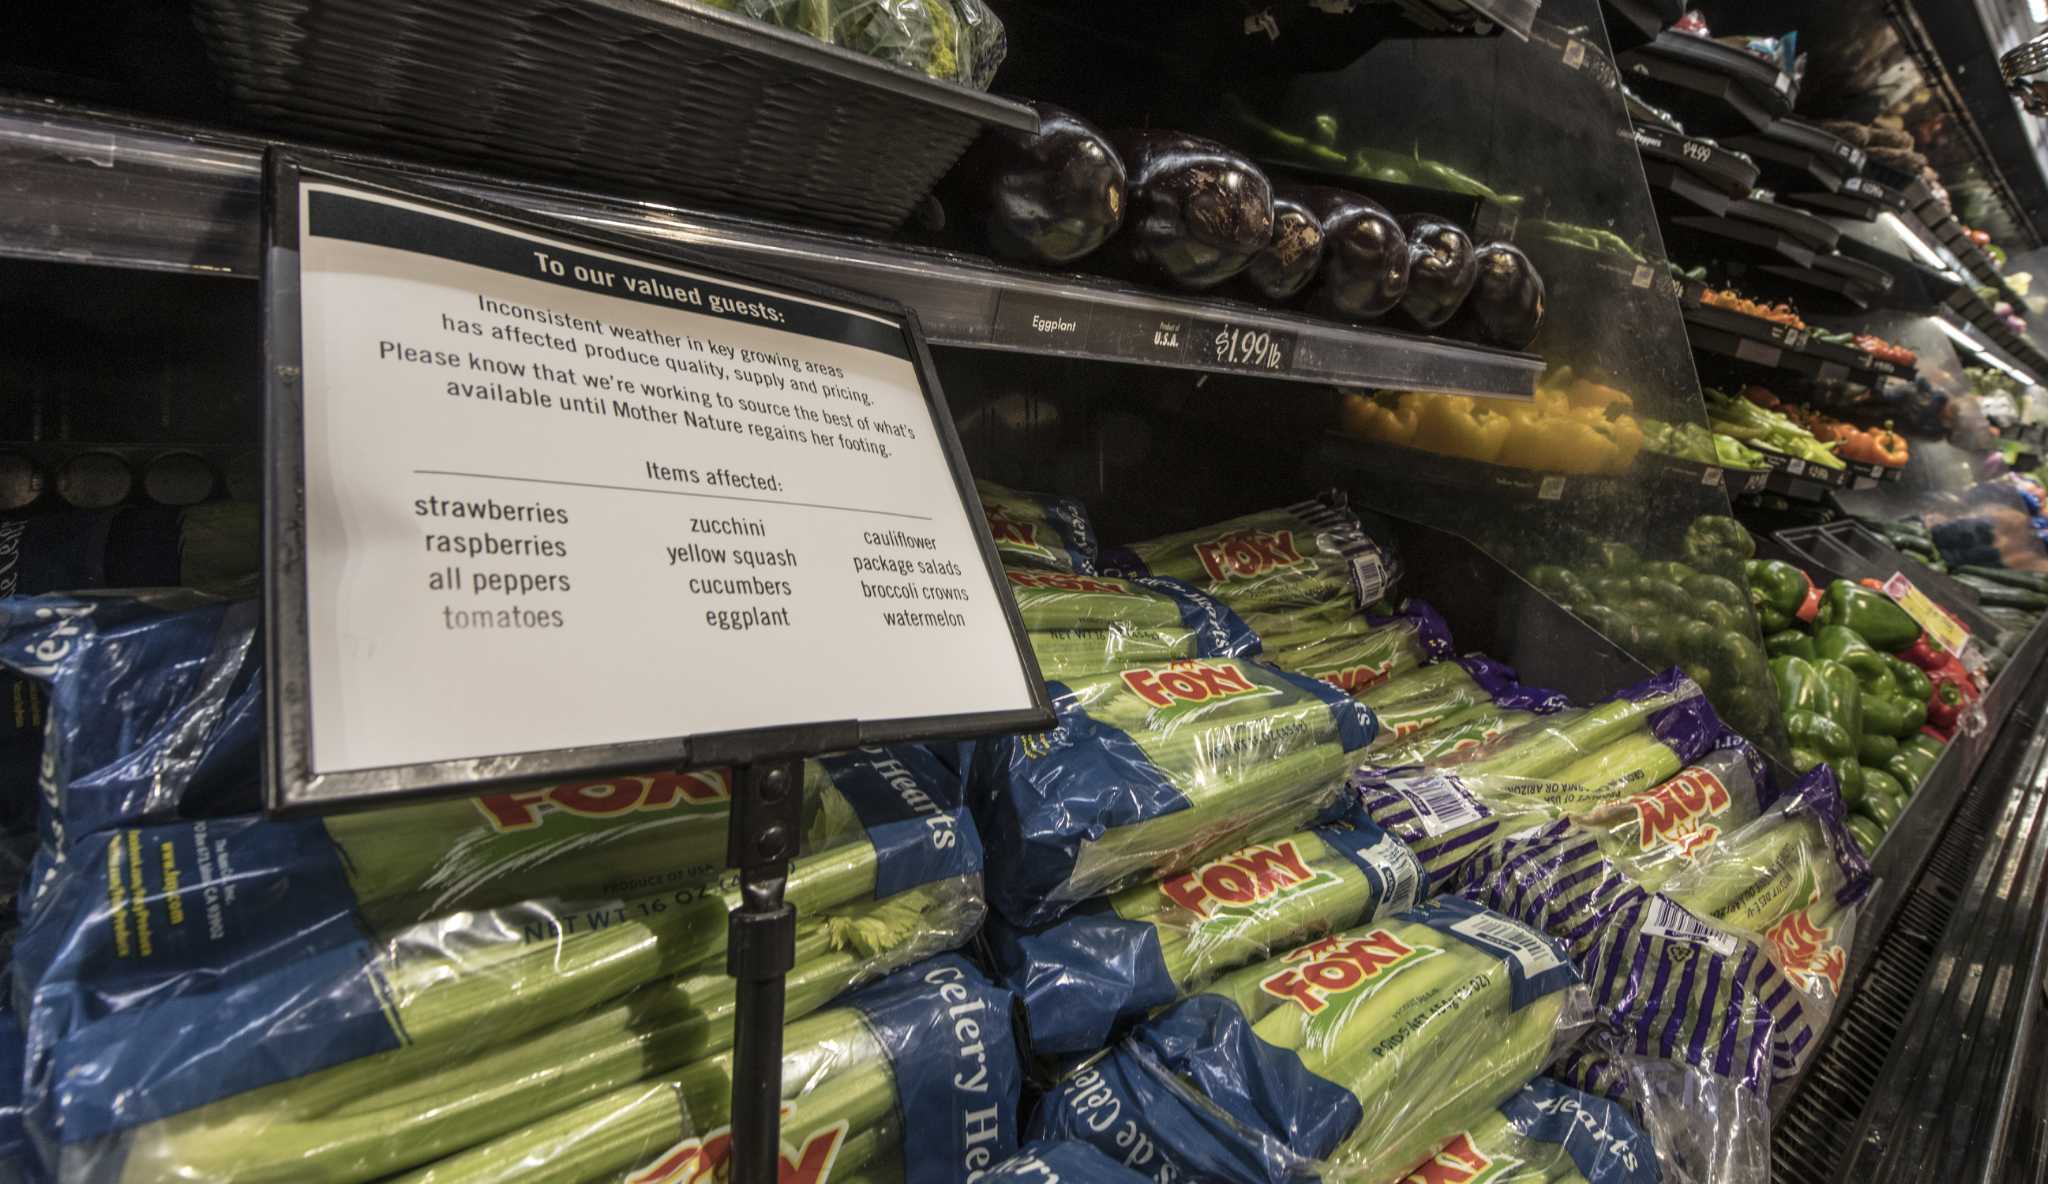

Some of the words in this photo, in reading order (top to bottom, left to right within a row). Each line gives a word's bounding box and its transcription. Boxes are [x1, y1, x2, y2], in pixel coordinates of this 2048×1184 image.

[533, 252, 565, 276] To
[574, 265, 615, 288] our
[623, 275, 702, 305] valued
[708, 294, 785, 323] guests:
[478, 295, 604, 335] Inconsistent
[610, 324, 681, 348] weather
[687, 336, 703, 352] in
[708, 340, 735, 360] key
[741, 349, 801, 373] growing
[805, 360, 844, 378] areas
[1032, 315, 1076, 333] Eggplant
[1154, 331, 1179, 347] U.S.A.
[442, 314, 483, 337] has
[492, 324, 577, 353] affected
[585, 342, 660, 367] produce
[666, 356, 730, 380] quality,
[734, 368, 785, 391] supply
[790, 379, 818, 394] and
[822, 384, 874, 406] pricing.
[380, 341, 460, 368] Please
[469, 353, 525, 377] know
[533, 363, 576, 386] that
[583, 374, 635, 394] we're
[641, 382, 712, 408] working
[716, 392, 734, 409] to
[738, 399, 791, 417] source
[794, 405, 819, 423] the
[823, 410, 854, 428] best
[857, 416, 871, 431] of
[873, 420, 915, 440] what's
[447, 381, 552, 408] available
[560, 396, 607, 416] until
[613, 400, 678, 426] Mother
[684, 411, 743, 434] Nature
[747, 422, 807, 444] regains
[810, 429, 835, 447] her
[838, 434, 892, 458] footing.
[646, 461, 700, 484] Items
[706, 469, 783, 492] affected:
[414, 495, 568, 524] strawberries
[689, 516, 766, 537] zucchini
[863, 529, 937, 551] cauliflower
[425, 532, 567, 558] raspberries
[666, 543, 726, 566] yellow
[732, 548, 797, 568] squash
[1196, 530, 1304, 583] FOXY
[853, 554, 914, 575] package
[917, 558, 962, 576] salads
[428, 567, 461, 590] all
[472, 571, 571, 595] peppers
[689, 576, 792, 597] cucumbers
[860, 580, 920, 600] broccoli
[922, 584, 969, 601] crowns
[442, 605, 564, 630] tomatoes
[706, 606, 790, 631] eggplant
[883, 609, 966, 628] watermelon
[1121, 664, 1258, 709] FOXY
[475, 768, 733, 832] FOX
[871, 757, 957, 851] Hearts
[1160, 840, 1316, 920] FOXY
[586, 908, 626, 932] WT
[638, 900, 667, 916] 16
[1261, 930, 1420, 1017] FOXY
[924, 966, 989, 1092] Celery
[1115, 1119, 1155, 1168] de
[1534, 1095, 1639, 1173] Hearts
